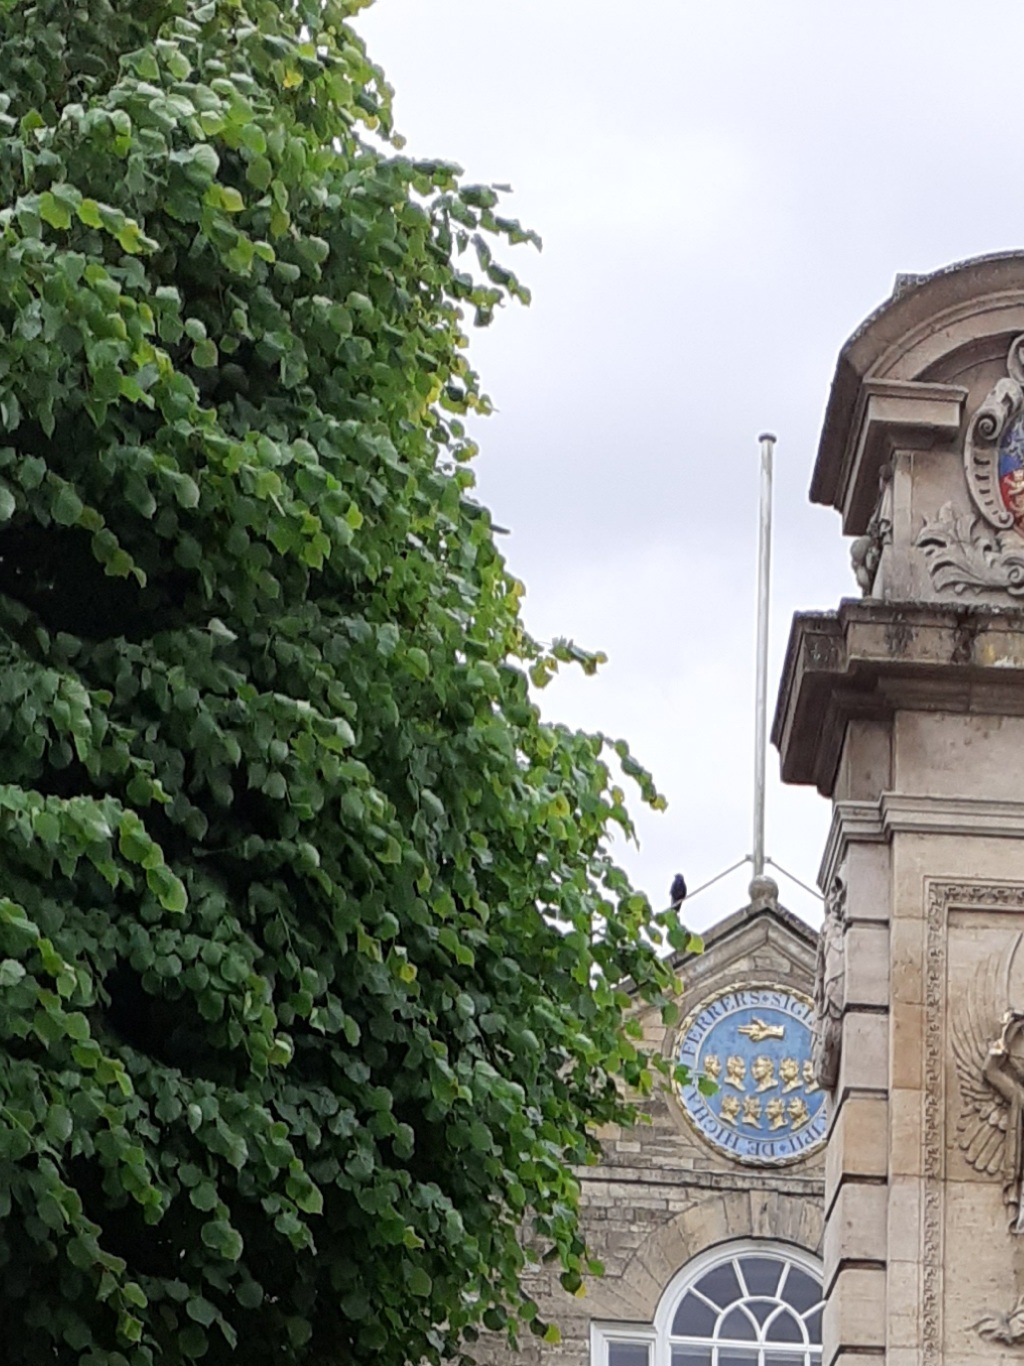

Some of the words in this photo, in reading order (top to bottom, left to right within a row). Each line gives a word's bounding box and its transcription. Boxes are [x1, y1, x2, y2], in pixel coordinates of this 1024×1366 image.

[681, 991, 760, 1057] FERRERS
[686, 1089, 740, 1150] HIGHA
[746, 1141, 775, 1157] DE
